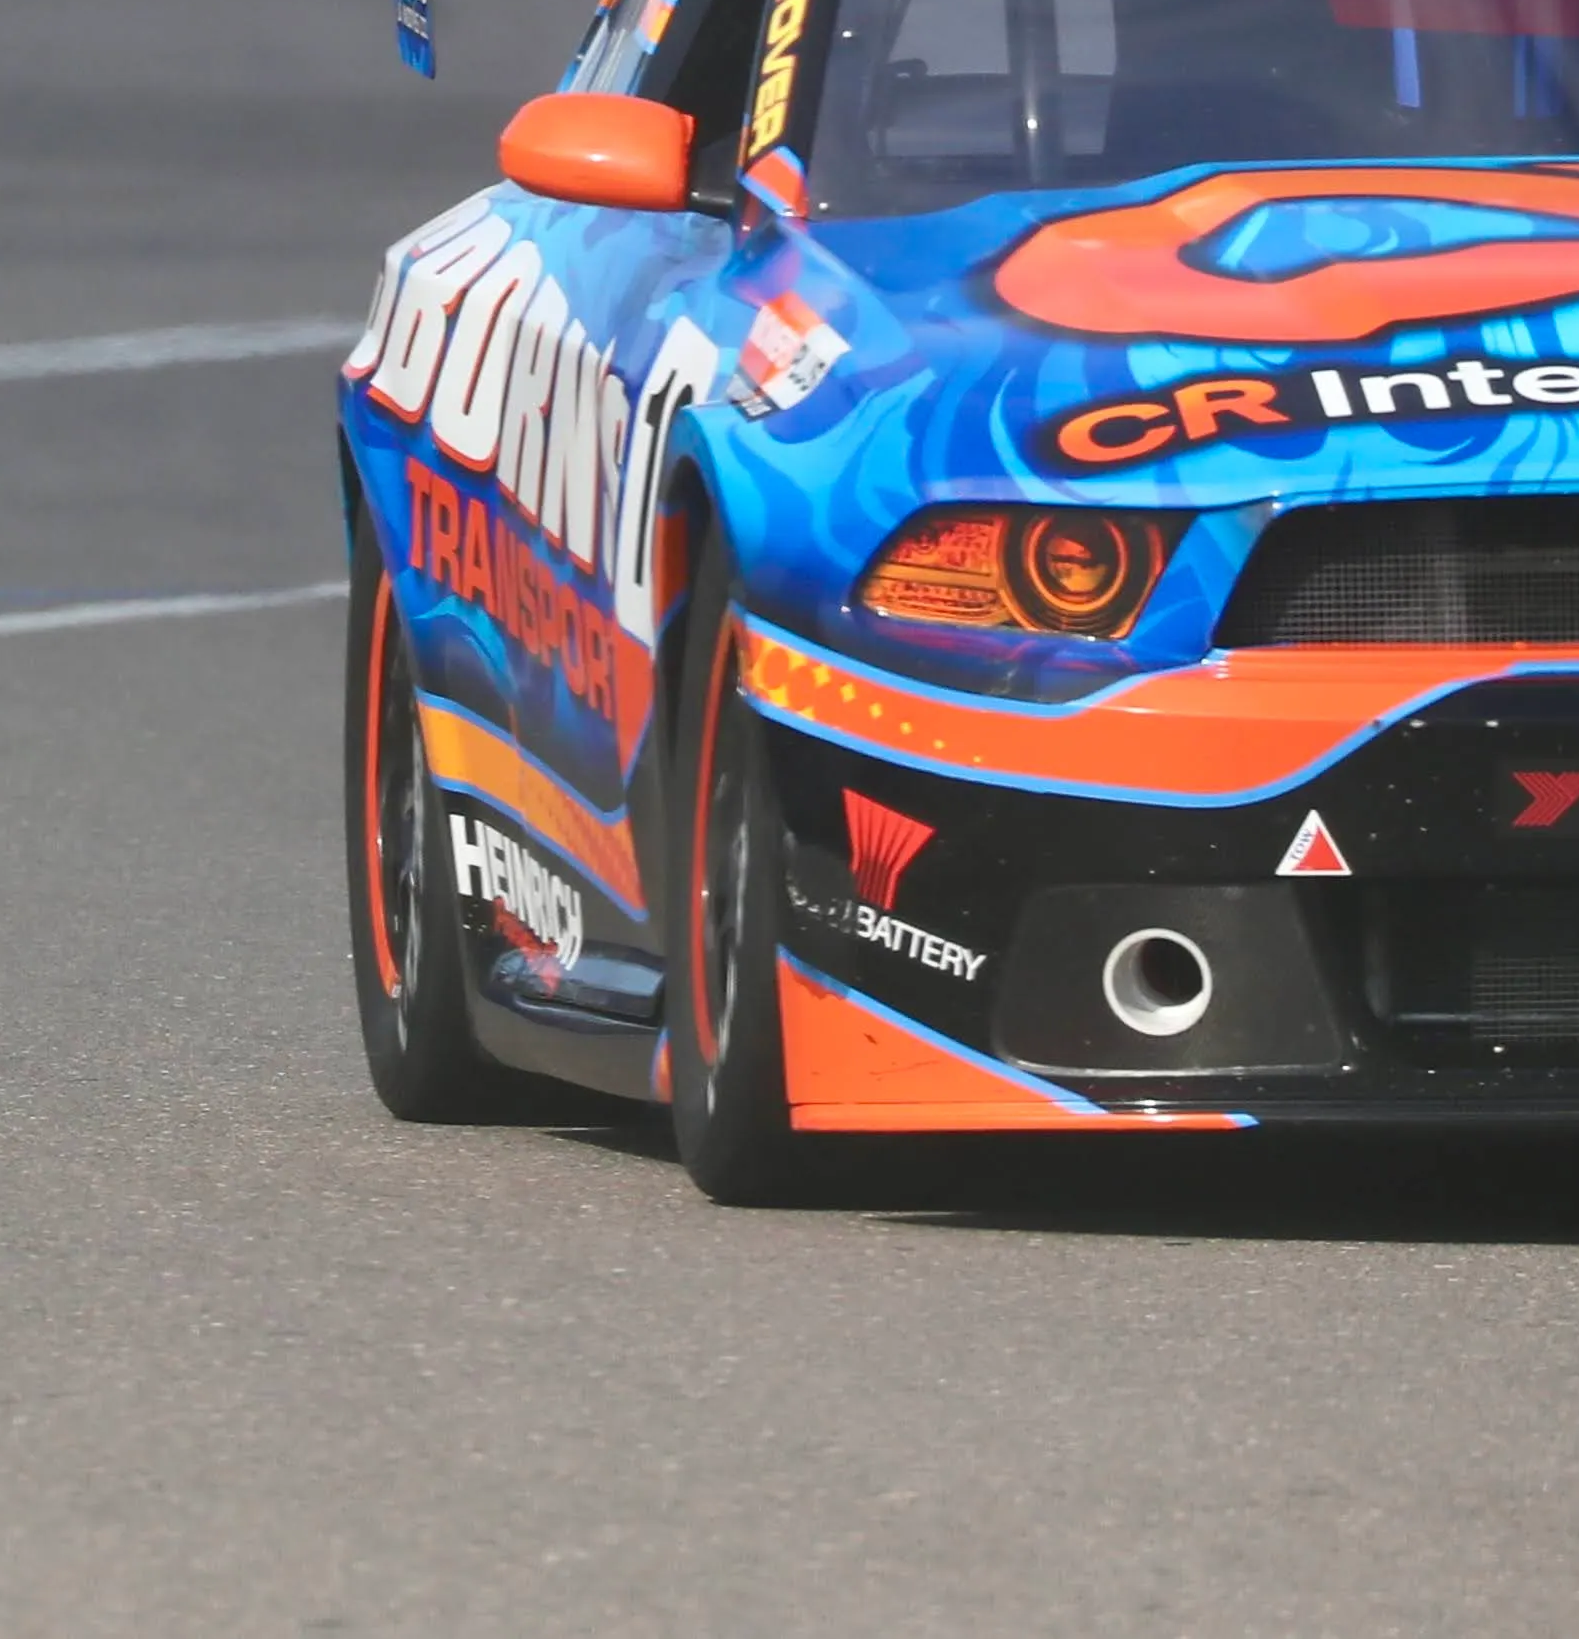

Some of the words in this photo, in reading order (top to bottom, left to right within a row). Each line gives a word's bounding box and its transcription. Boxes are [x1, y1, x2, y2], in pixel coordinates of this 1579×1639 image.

[634, 369, 694, 589] 1
[1058, 379, 1290, 463] CR
[449, 813, 584, 971] HEINRICH
